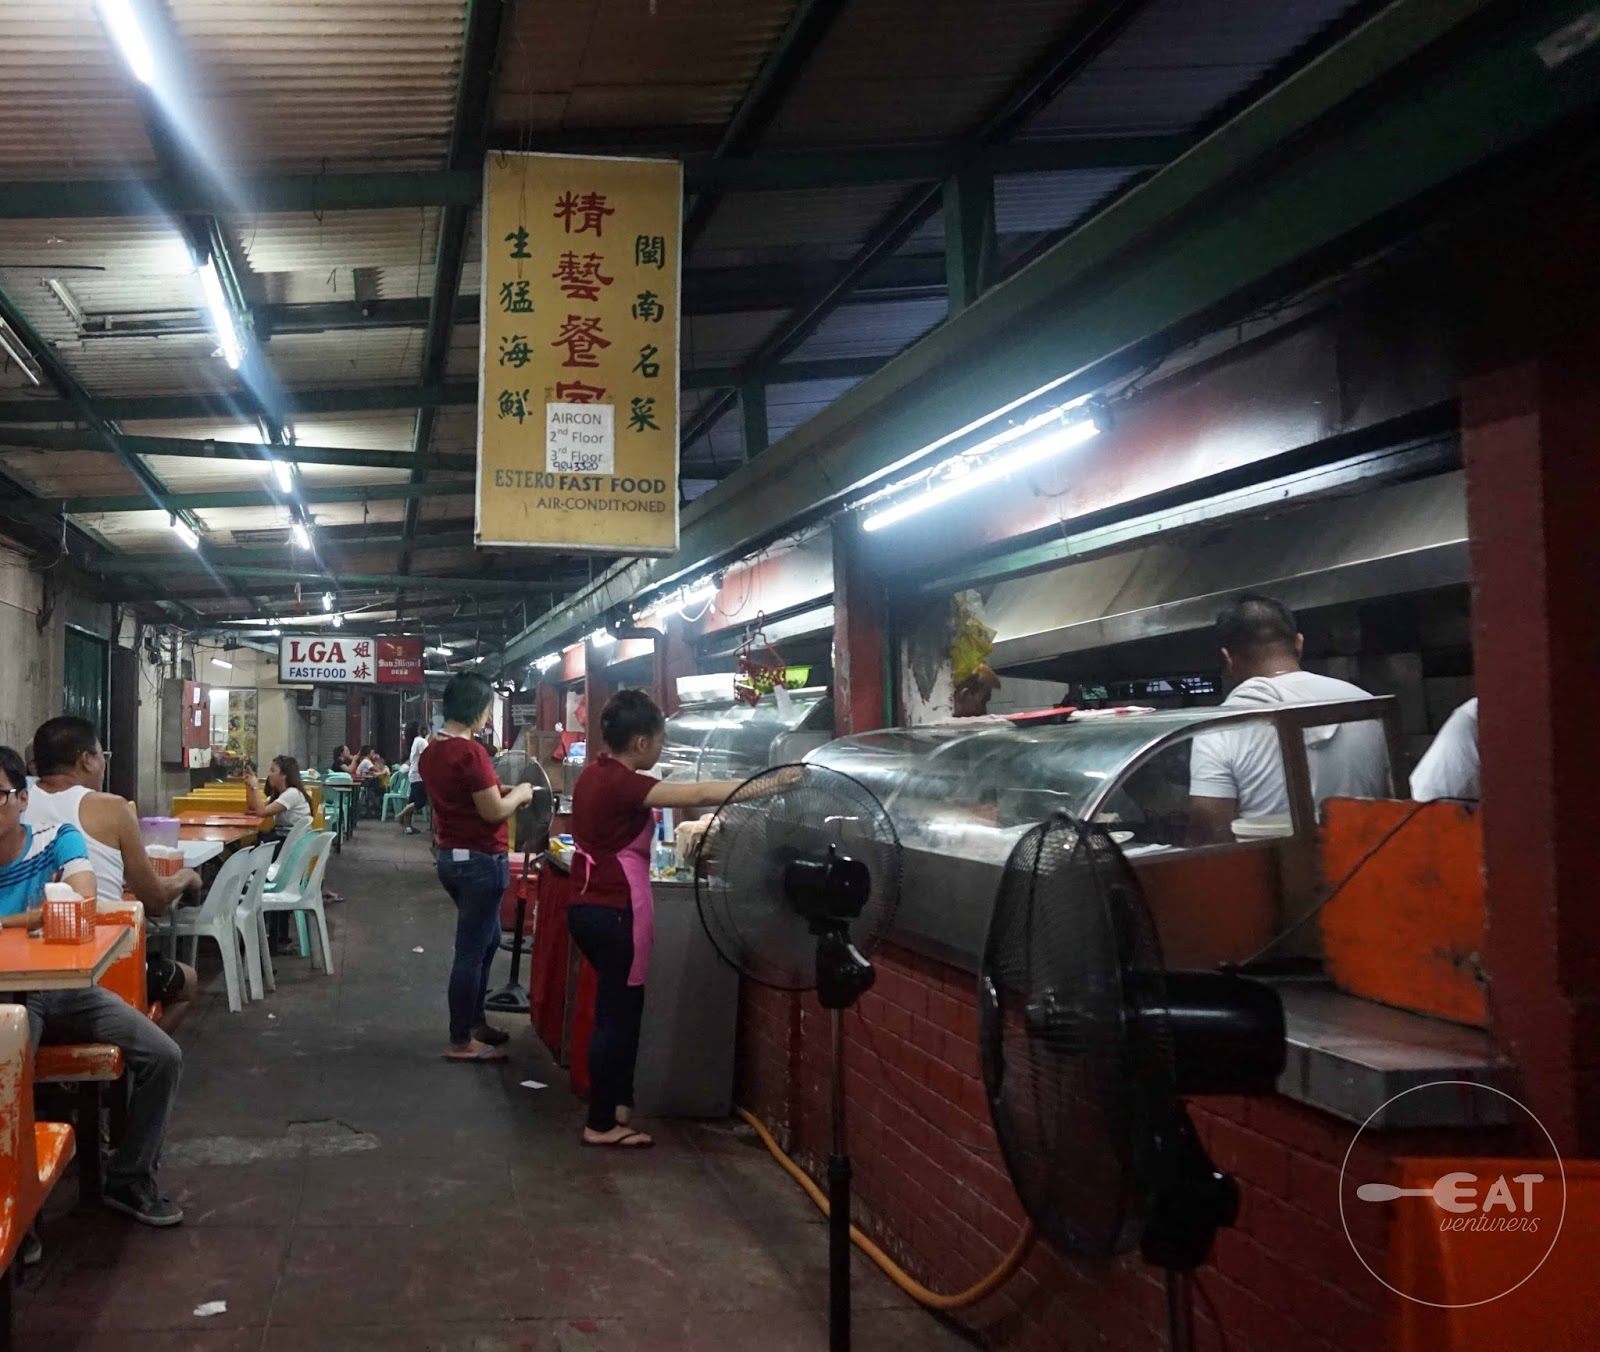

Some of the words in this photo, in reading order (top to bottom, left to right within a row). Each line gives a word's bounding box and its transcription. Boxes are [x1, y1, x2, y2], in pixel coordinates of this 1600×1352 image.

[497, 226, 535, 424] 生猛海鮮
[626, 234, 665, 432] 閩南名菜
[551, 412, 602, 425] AIRCON
[550, 428, 568, 442] 2nd
[572, 431, 604, 444] Floor
[550, 446, 567, 461] 3rd
[571, 450, 603, 462] Floor
[495, 469, 555, 489] ESTERO
[559, 475, 603, 492] FAST
[611, 477, 666, 494] FOOD
[536, 497, 666, 513] AIR-CONDITIONED
[290, 641, 347, 664] LGA
[352, 641, 371, 680] 姐妹
[289, 667, 347, 679] FASTFOOD
